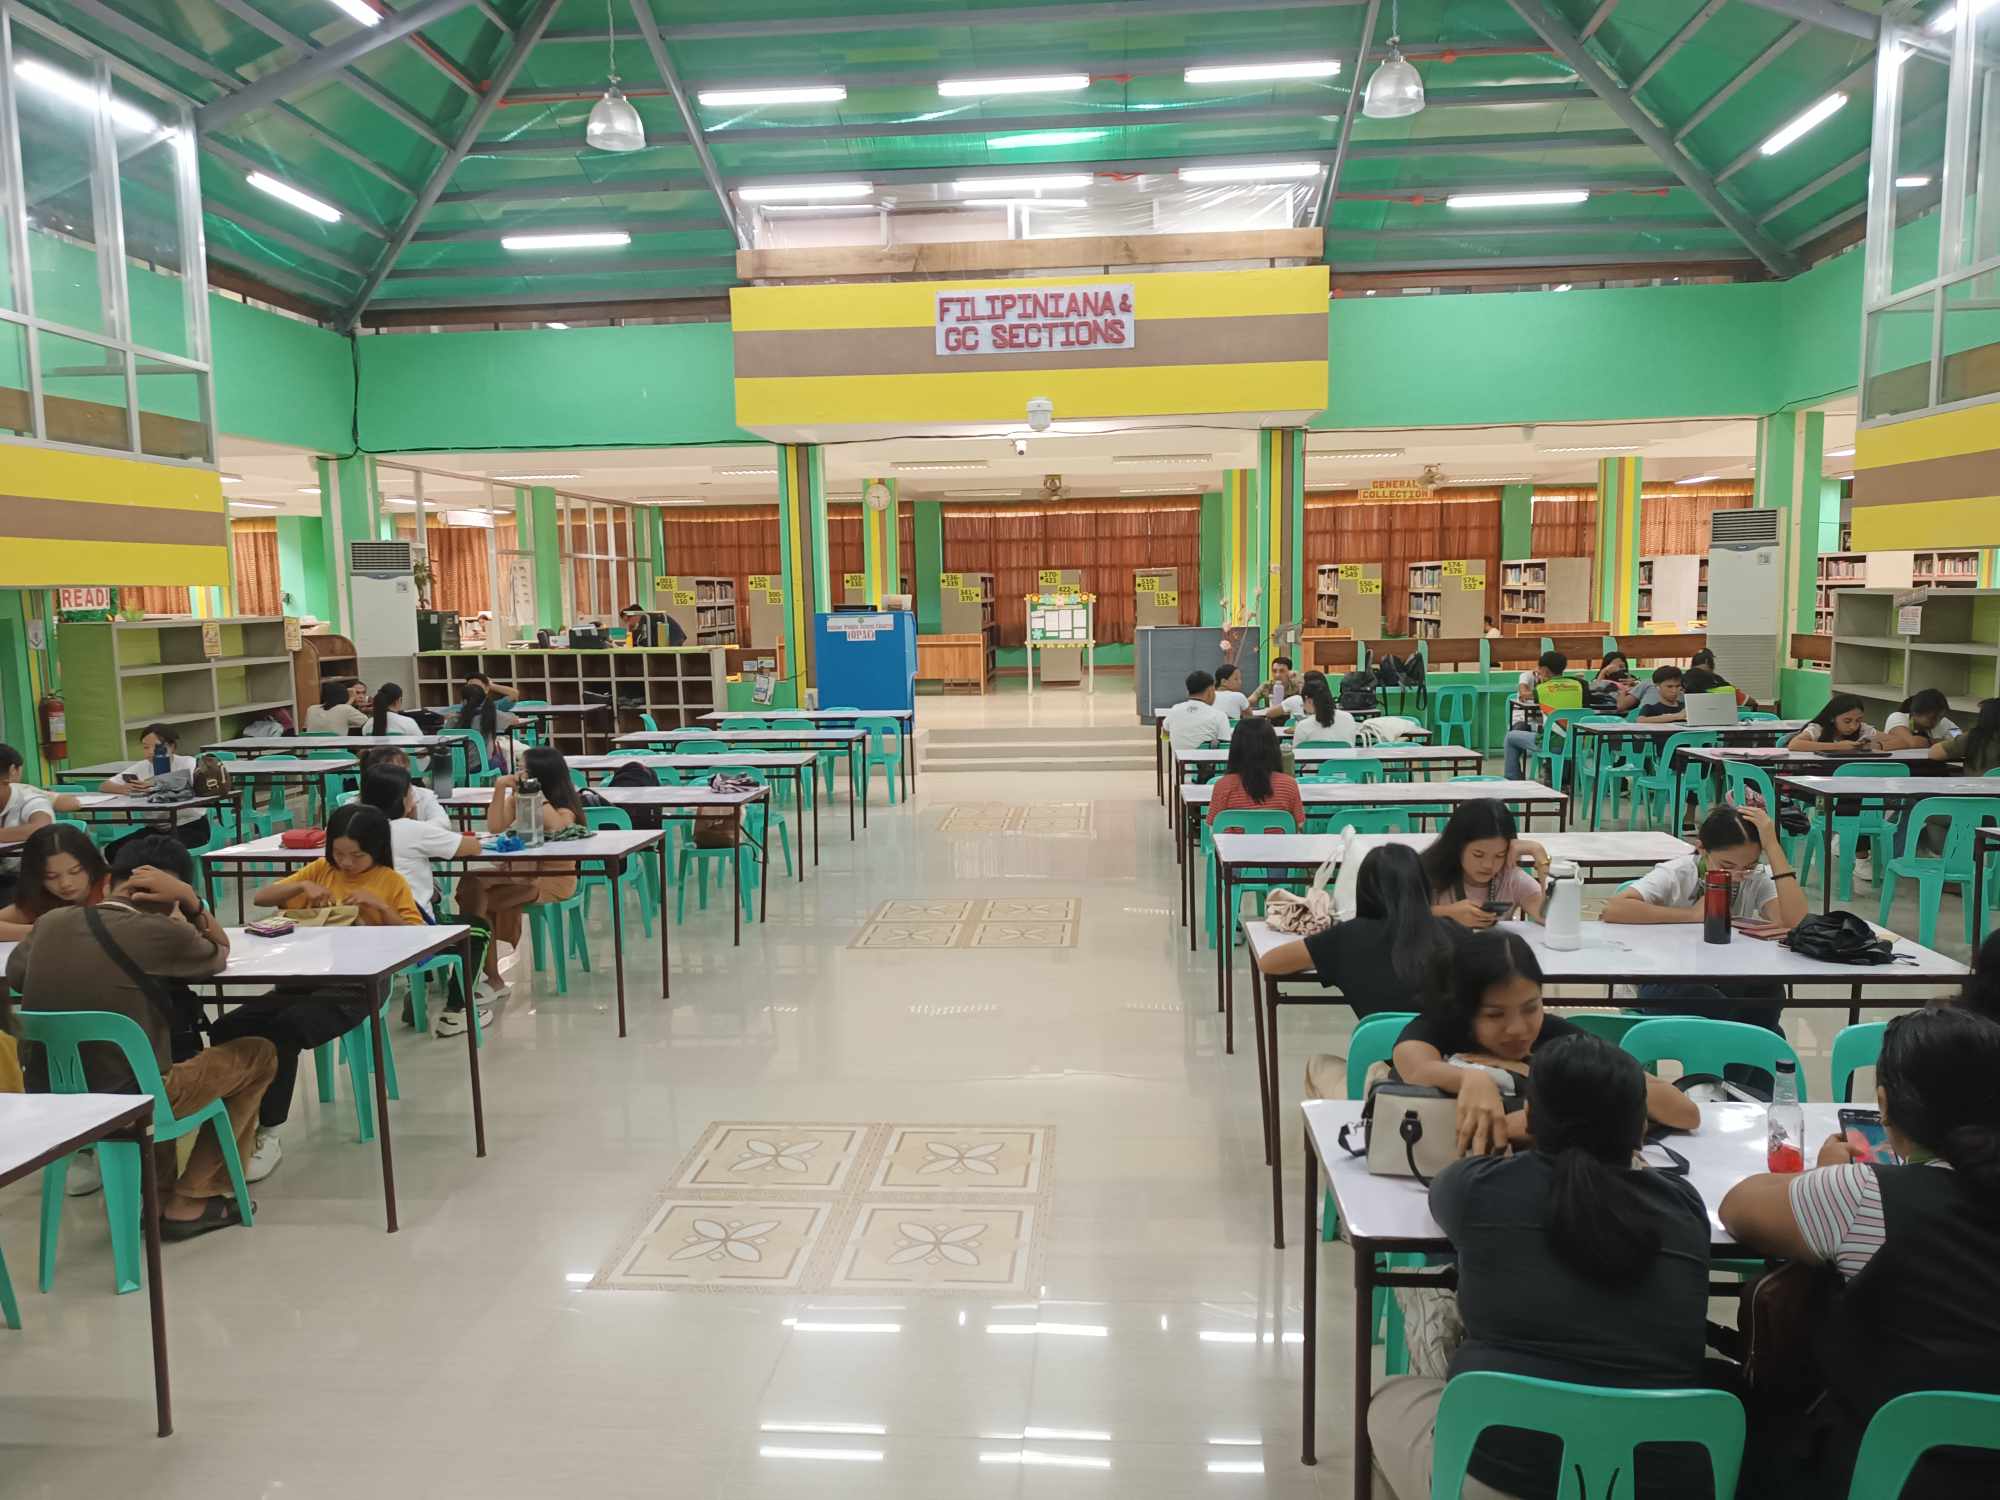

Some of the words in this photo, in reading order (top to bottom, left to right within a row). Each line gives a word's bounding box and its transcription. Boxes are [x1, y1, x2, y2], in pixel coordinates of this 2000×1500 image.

[939, 291, 1116, 322] FILIPINIANA
[1119, 293, 1132, 313] &
[944, 326, 979, 351] GC
[991, 319, 1126, 349] SECTIONS
[1362, 488, 1428, 498] COLLECTION
[1372, 480, 1417, 489] GENERAL
